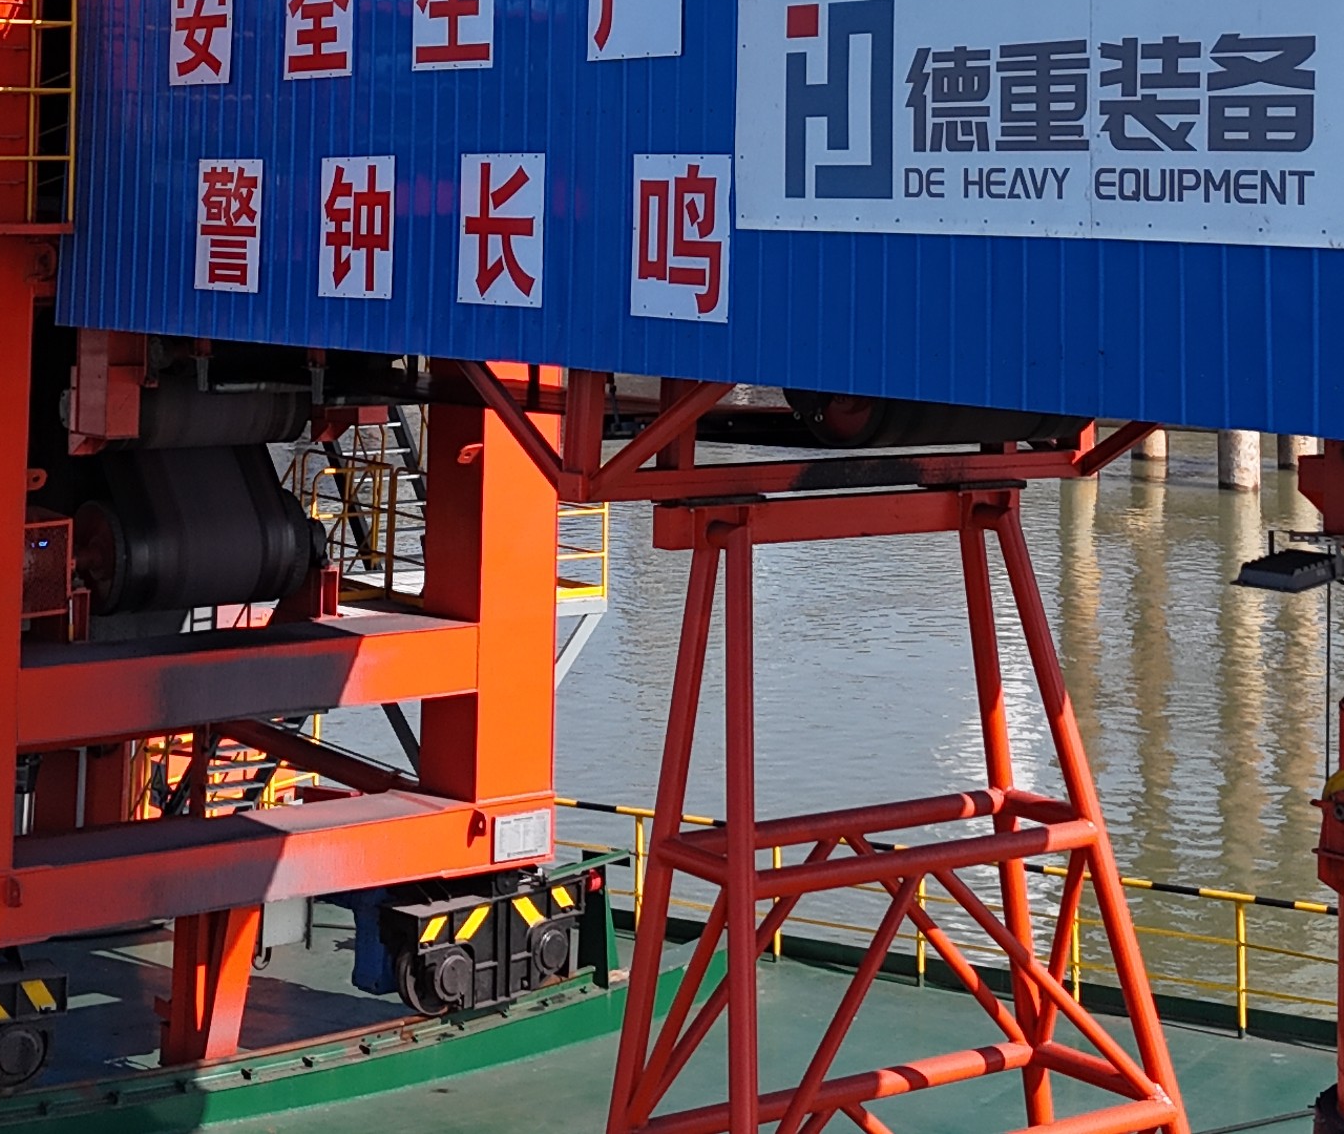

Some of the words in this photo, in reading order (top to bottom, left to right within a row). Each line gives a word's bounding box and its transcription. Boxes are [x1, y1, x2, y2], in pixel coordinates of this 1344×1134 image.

[905, 33, 1316, 153] 德重装备
[201, 163, 722, 314] 警钟长鸣
[904, 168, 945, 198] DE
[963, 167, 1071, 200] HEAVY
[1094, 168, 1316, 206] EQUIPMENT
